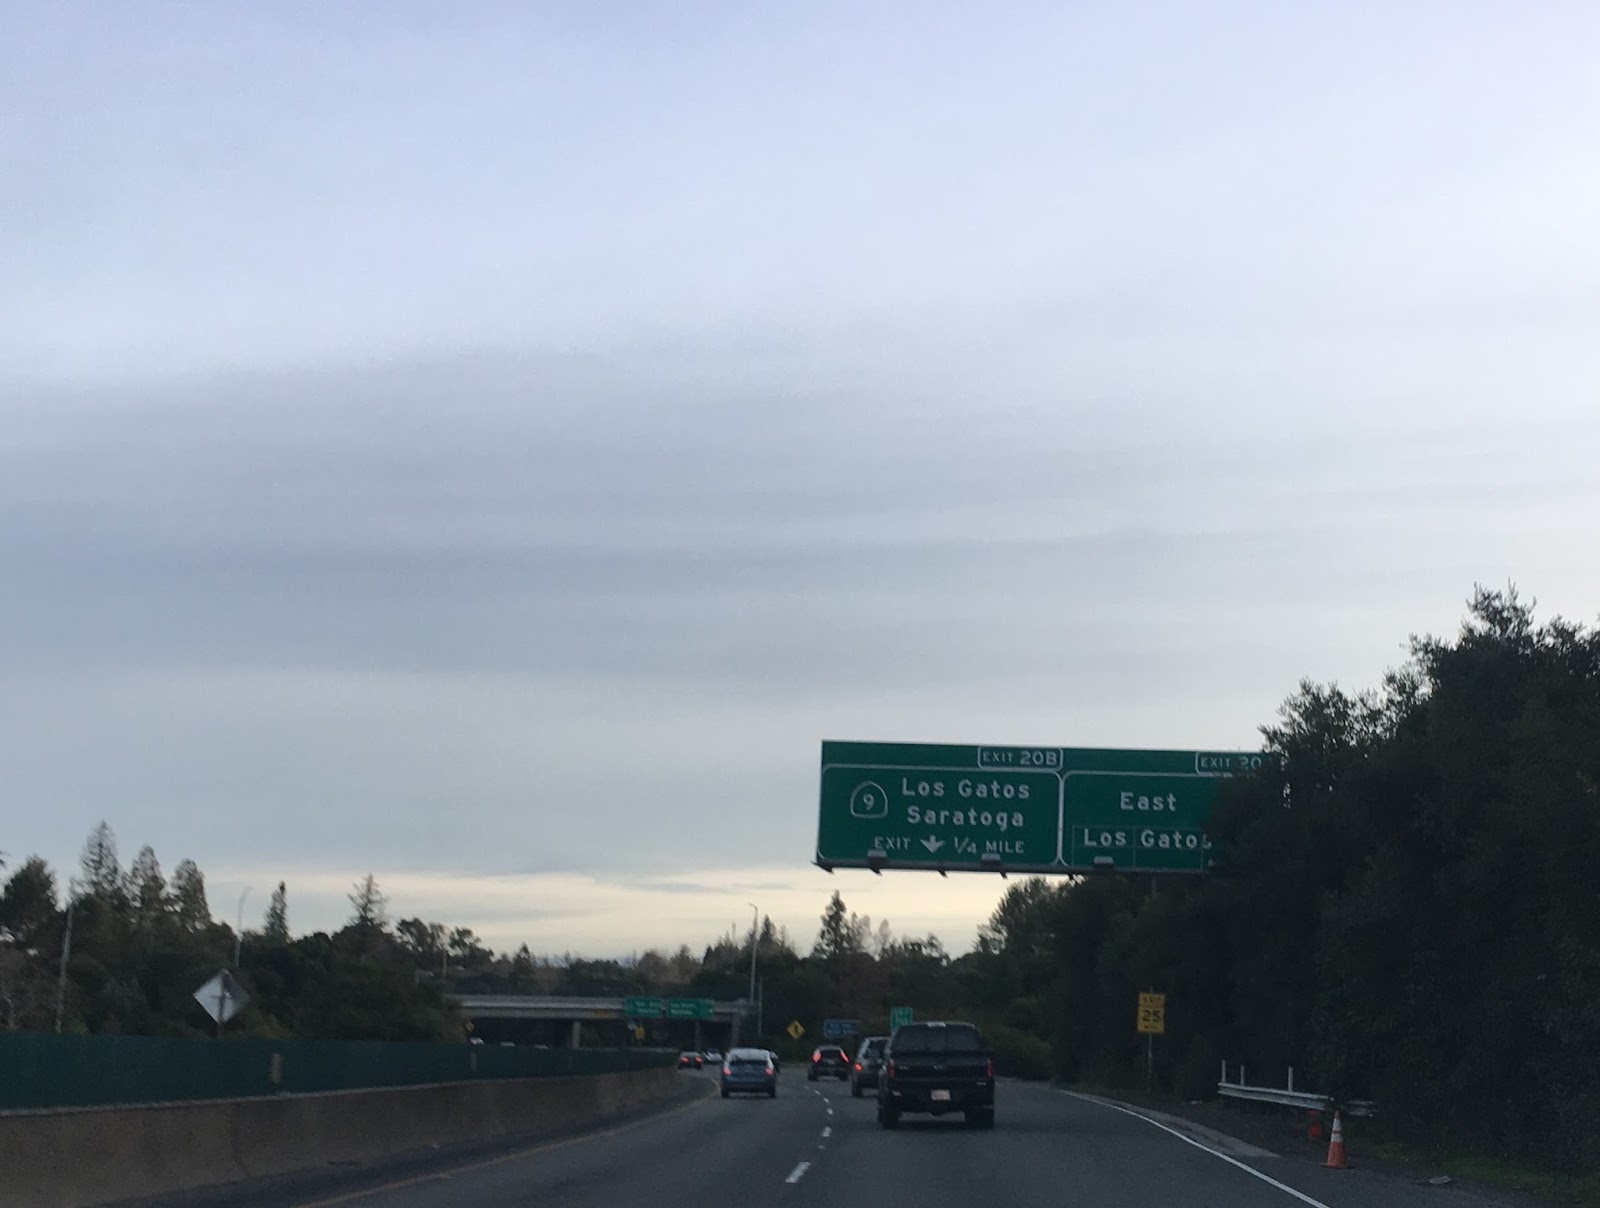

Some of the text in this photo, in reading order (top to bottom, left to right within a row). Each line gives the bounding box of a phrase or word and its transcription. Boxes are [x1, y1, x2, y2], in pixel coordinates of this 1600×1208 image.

[982, 751, 1058, 766] EXIT 20B
[1200, 757, 1231, 769] EXIT
[902, 777, 1030, 799] Los Gatos
[862, 793, 875, 811] 9
[1120, 791, 1177, 812] East
[907, 805, 1024, 831] Saratoga
[874, 836, 911, 850] EXIT
[985, 840, 1025, 854] MILE
[1084, 828, 1127, 848] Los
[1142, 1010, 1161, 1022] 25
